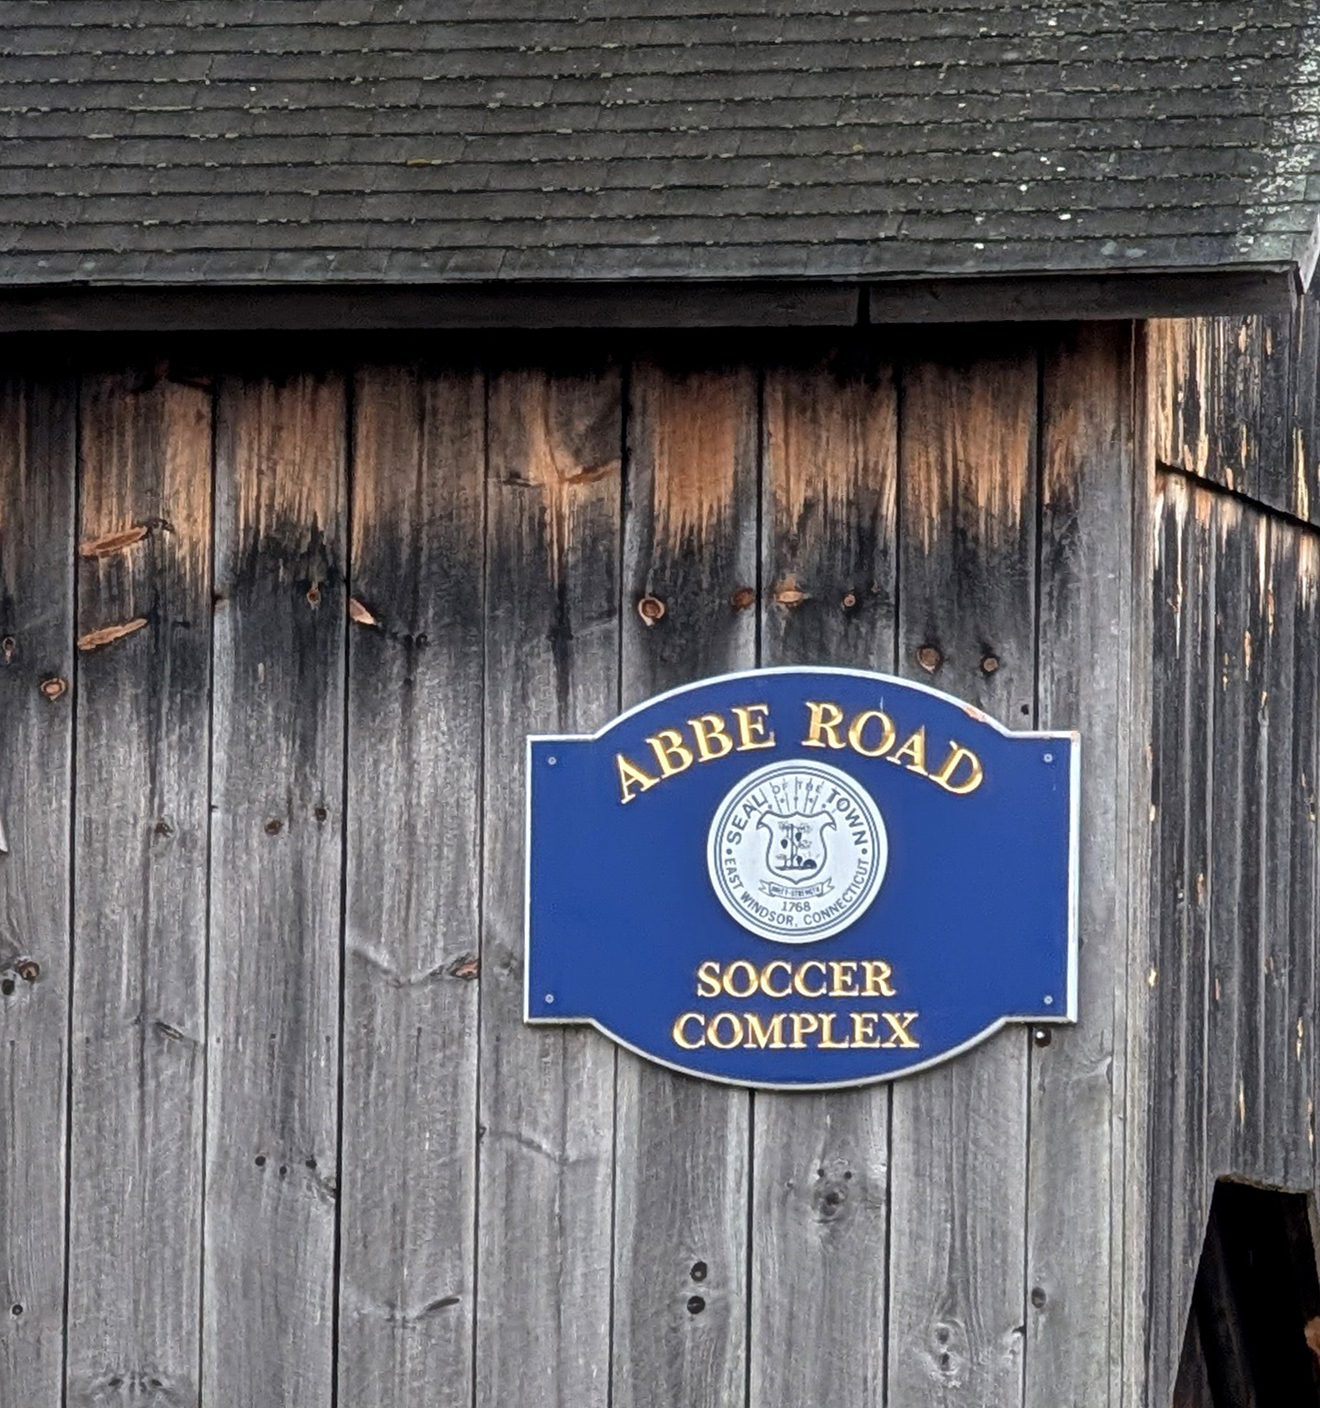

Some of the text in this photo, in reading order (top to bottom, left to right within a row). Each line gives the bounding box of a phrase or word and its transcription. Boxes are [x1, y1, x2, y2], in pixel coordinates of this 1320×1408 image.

[612, 700, 985, 805] ABBE ROAD
[726, 792, 769, 846] SEAL
[771, 782, 789, 796] OF
[825, 786, 869, 847] TOWN
[723, 857, 745, 890] EAST
[803, 857, 870, 926] CONNECTICUT
[780, 900, 812, 913] 1768
[697, 960, 897, 998] SOCCER
[672, 1011, 921, 1050] COMPLEX
